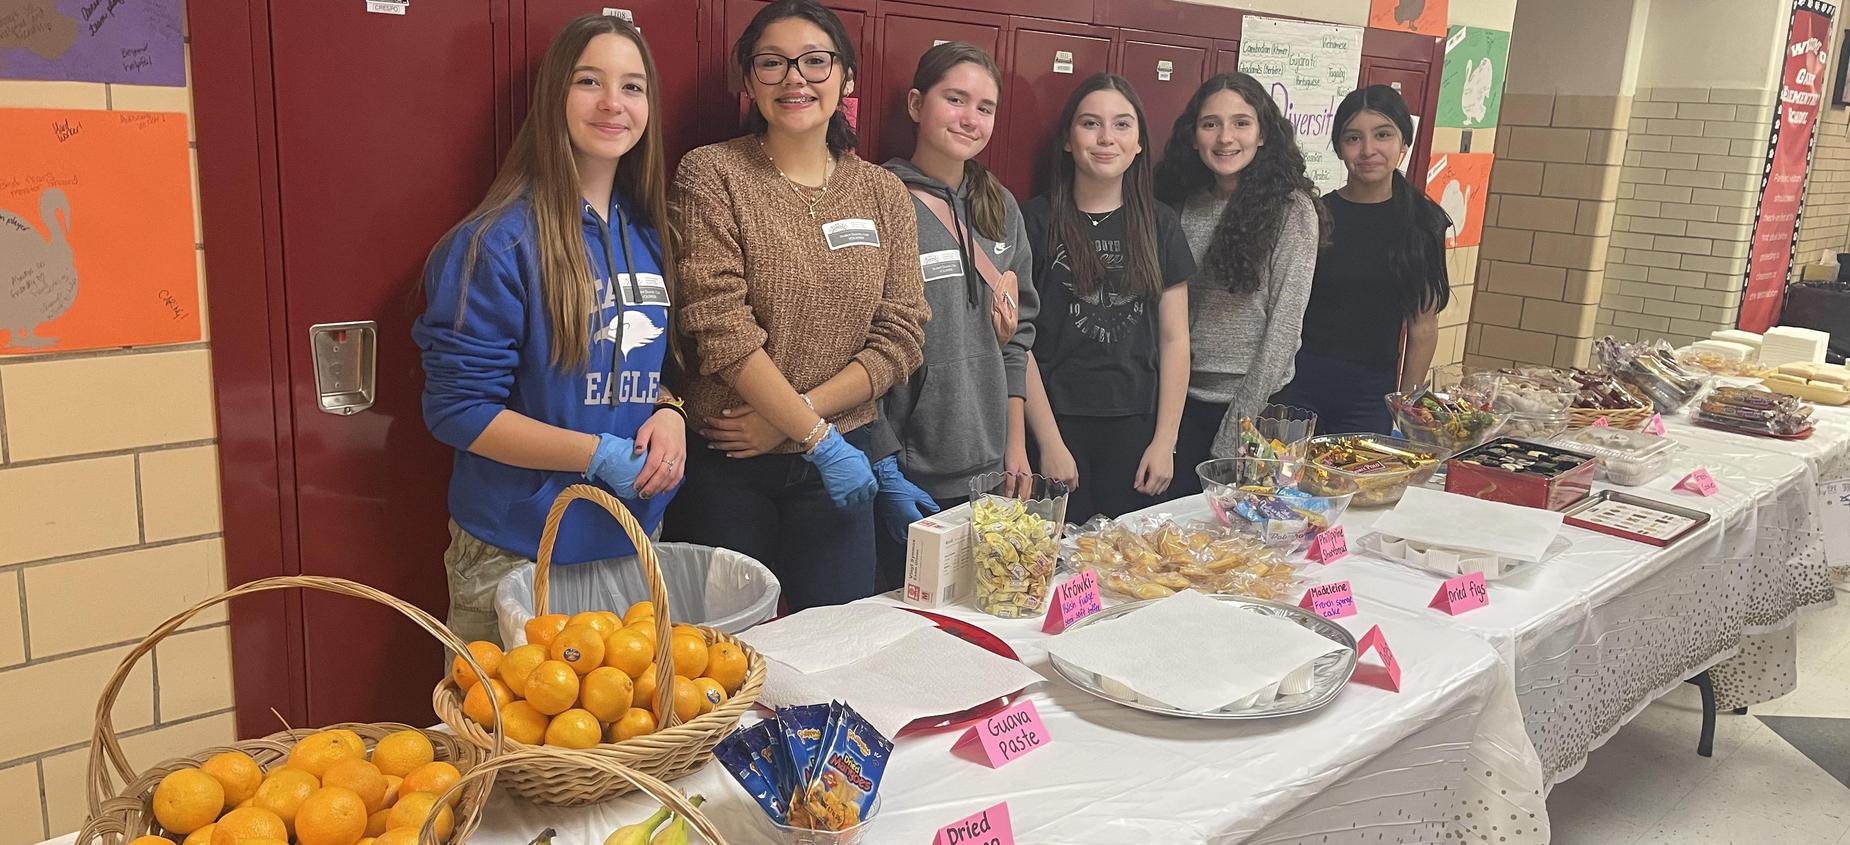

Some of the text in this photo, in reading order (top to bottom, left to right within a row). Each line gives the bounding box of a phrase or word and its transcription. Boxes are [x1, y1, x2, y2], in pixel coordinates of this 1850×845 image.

[1311, 582, 1347, 598] Madeleine
[1448, 580, 1486, 603] Dried figs
[1314, 600, 1334, 610] French
[1323, 608, 1340, 618] cake
[987, 711, 1032, 737] Guava
[998, 729, 1040, 760] Paste
[828, 753, 873, 792] Mangoes
[843, 753, 861, 774] Dried
[946, 810, 991, 845] Dried
